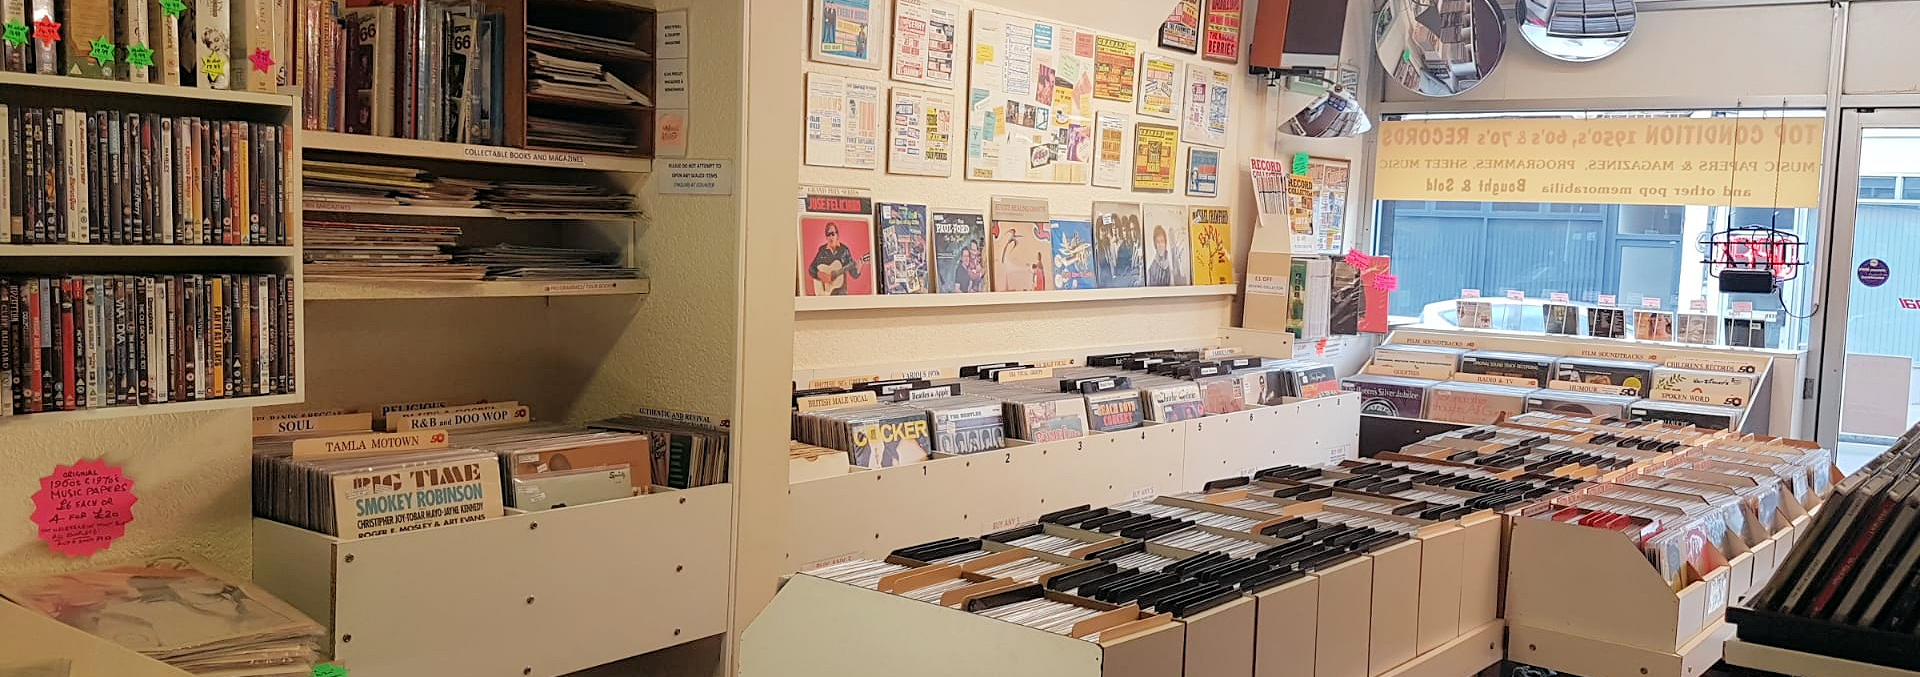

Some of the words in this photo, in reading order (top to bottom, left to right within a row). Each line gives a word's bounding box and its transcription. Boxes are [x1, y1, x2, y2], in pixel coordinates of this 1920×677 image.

[360, 24, 376, 41] 66
[454, 35, 470, 50] 66
[1208, 40, 1235, 55] BERRIES
[464, 148, 508, 160] COLLECTABLE
[510, 152, 532, 161] BOOKS
[533, 153, 547, 161] AND
[548, 154, 584, 163] MAGAZINES
[1251, 158, 1281, 172] RECORD
[1287, 178, 1313, 189] RECORD
[215, 331, 222, 341] AS
[1423, 339, 1463, 347] SOUNDTRACKS
[1705, 363, 1736, 372] RECORDS
[1378, 388, 1397, 397] Silver
[1662, 392, 1687, 401] SPOKEN
[1724, 398, 1742, 406] 50
[808, 397, 831, 408] BRITISH
[833, 397, 849, 406] MALE
[850, 395, 868, 403] VOCAL
[411, 418, 437, 429] R&B
[455, 414, 479, 425] DOO
[482, 411, 508, 421] WOP
[685, 413, 710, 423] REVIVAL
[278, 420, 314, 432] SOUL
[854, 420, 928, 447] COCKER
[1141, 431, 1145, 439] 4
[325, 440, 367, 452] TAMLA
[372, 435, 419, 449] MOTOWN
[430, 433, 444, 443] 50
[1078, 441, 1082, 450] 3
[1006, 453, 1010, 463] 2
[410, 464, 480, 488] TIME
[923, 466, 927, 475] 1
[51, 489, 82, 500] MUSIC
[86, 483, 127, 495] PAPERS
[356, 492, 412, 516] SMOKEY
[416, 483, 483, 508] ROBINSON
[93, 507, 119, 519] £20
[460, 502, 483, 513] KENNEDY
[400, 523, 432, 532] MOSLEY
[460, 514, 486, 523] EVANS
